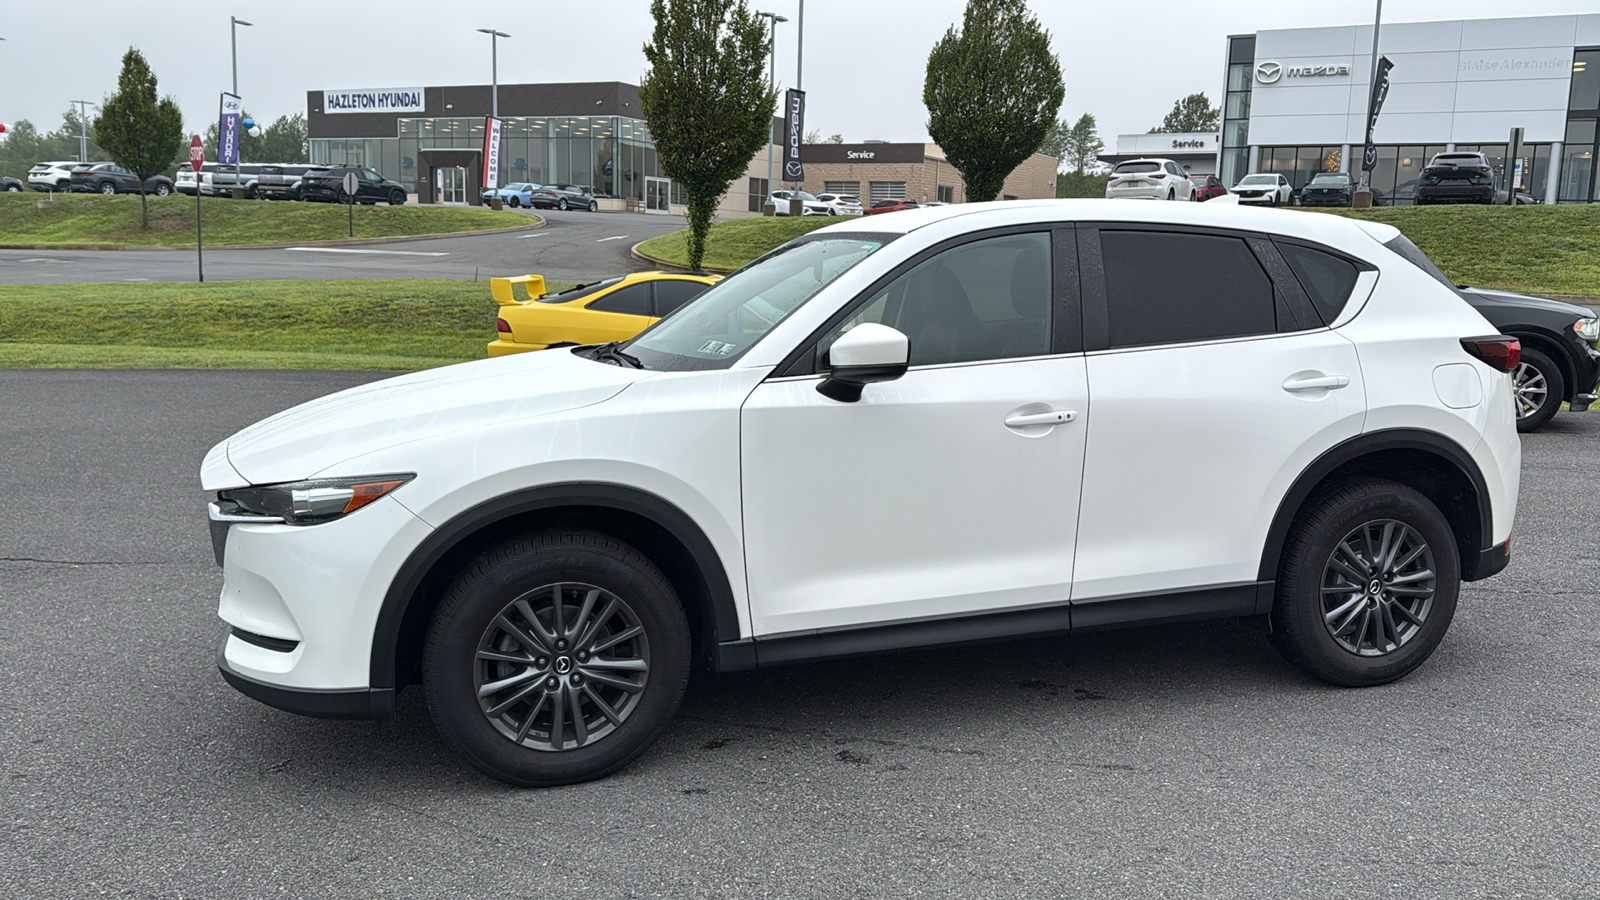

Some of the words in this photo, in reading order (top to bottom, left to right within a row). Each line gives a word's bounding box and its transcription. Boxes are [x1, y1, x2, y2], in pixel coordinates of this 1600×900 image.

[327, 93, 376, 109] HAZLETON
[377, 91, 421, 108] HYUNDAI
[224, 115, 235, 163] HYUNDAI
[1172, 138, 1205, 149] Service
[190, 146, 204, 161] STOP
[489, 127, 500, 181] WELCOME
[846, 150, 876, 159] Service
